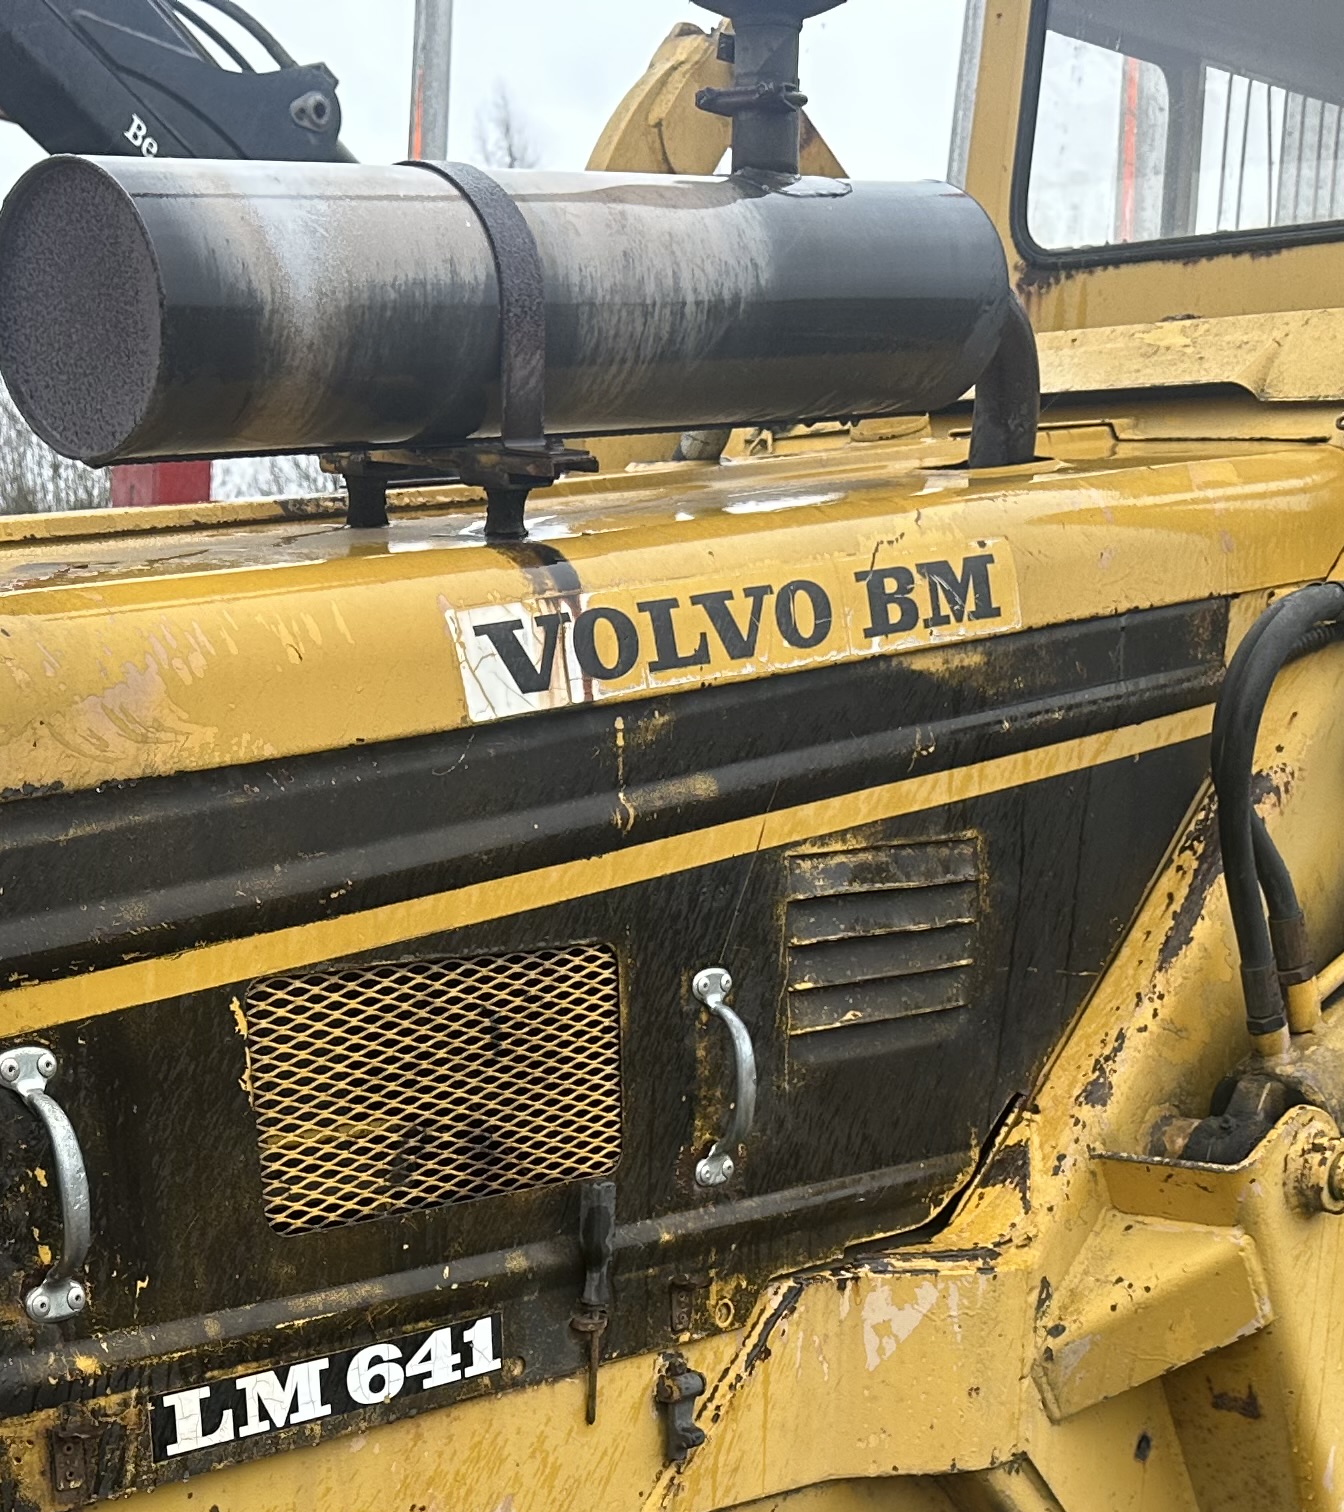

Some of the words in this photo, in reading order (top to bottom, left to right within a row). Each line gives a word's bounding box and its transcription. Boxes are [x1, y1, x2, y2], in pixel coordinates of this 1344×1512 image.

[475, 578, 832, 695] VOLVO
[854, 552, 1002, 638] BM
[162, 1357, 332, 1456] LM
[346, 1316, 502, 1405] 641
